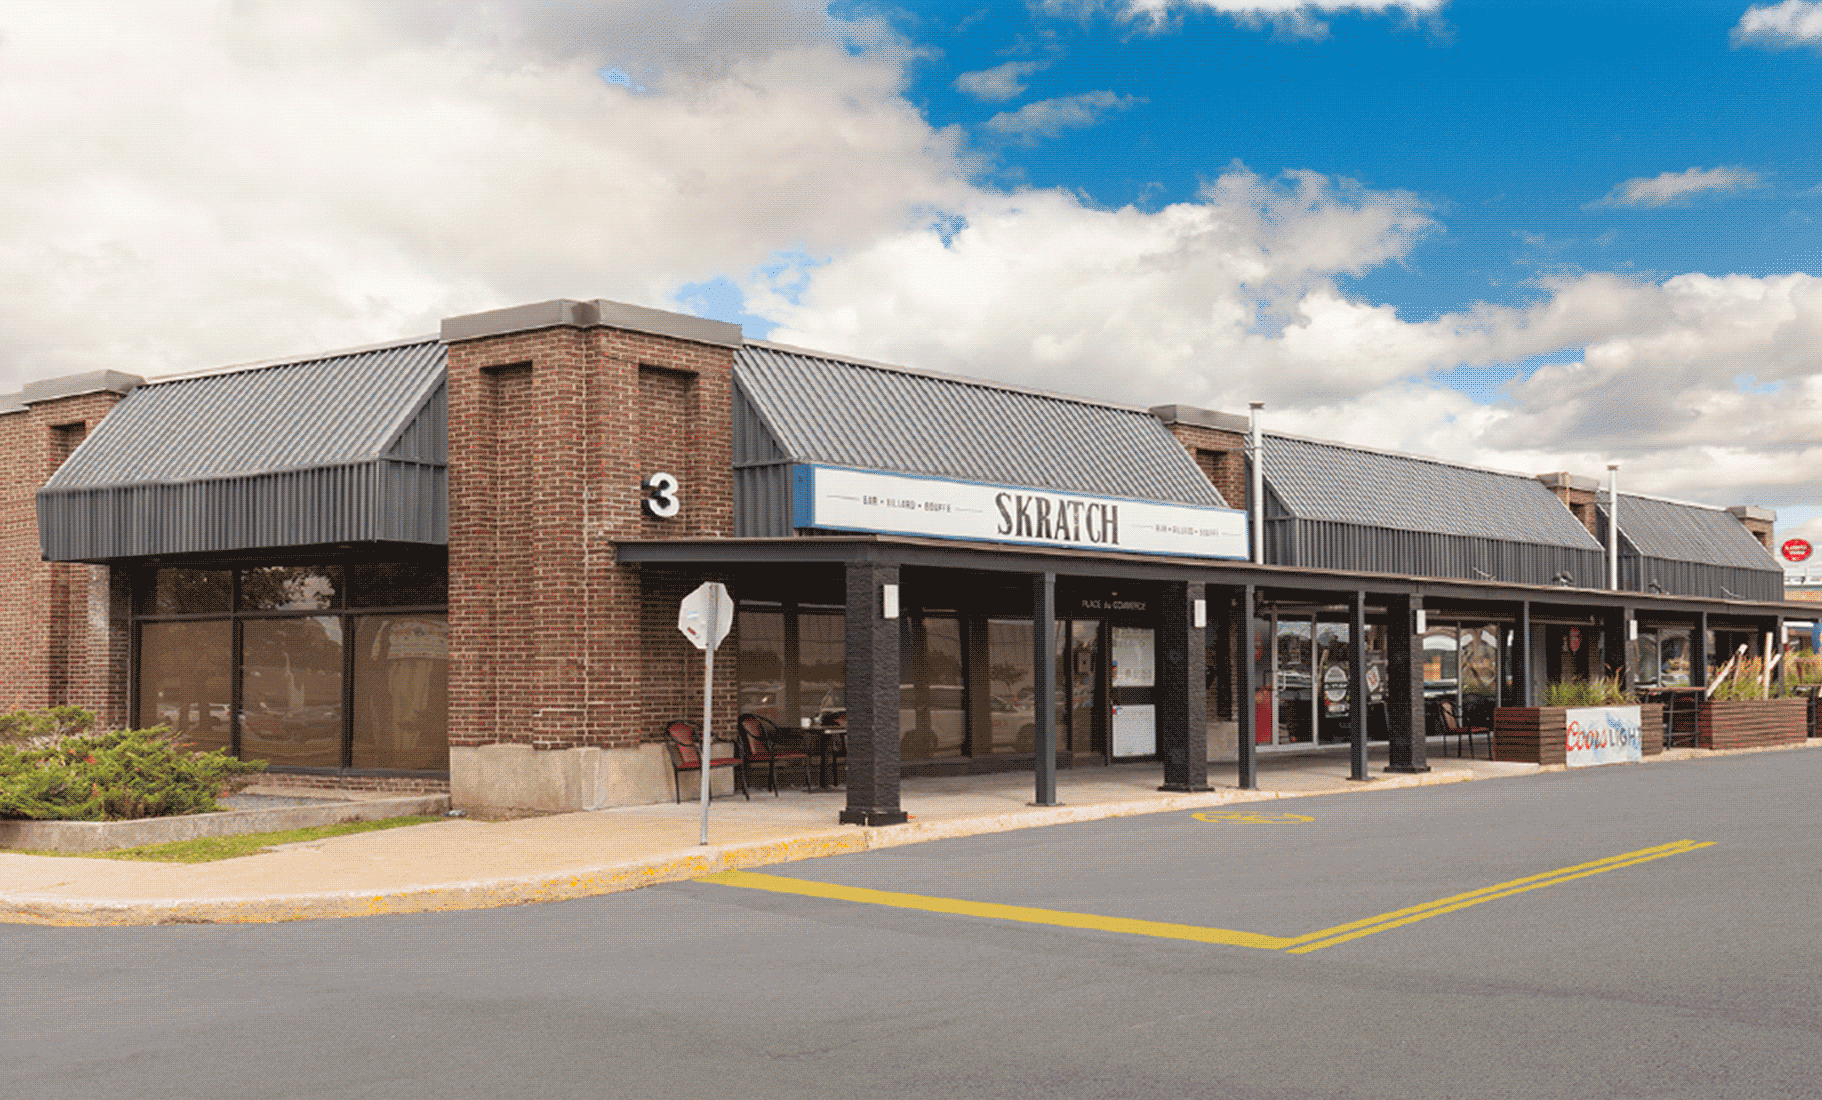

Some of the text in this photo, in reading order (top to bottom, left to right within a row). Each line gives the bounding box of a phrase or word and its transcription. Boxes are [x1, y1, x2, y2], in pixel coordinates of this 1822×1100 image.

[648, 471, 680, 518] 3
[862, 495, 878, 506] BAR
[886, 498, 916, 510] BILLARD
[995, 492, 1120, 545] SKRATCH
[1608, 727, 1641, 747] LIGHT
